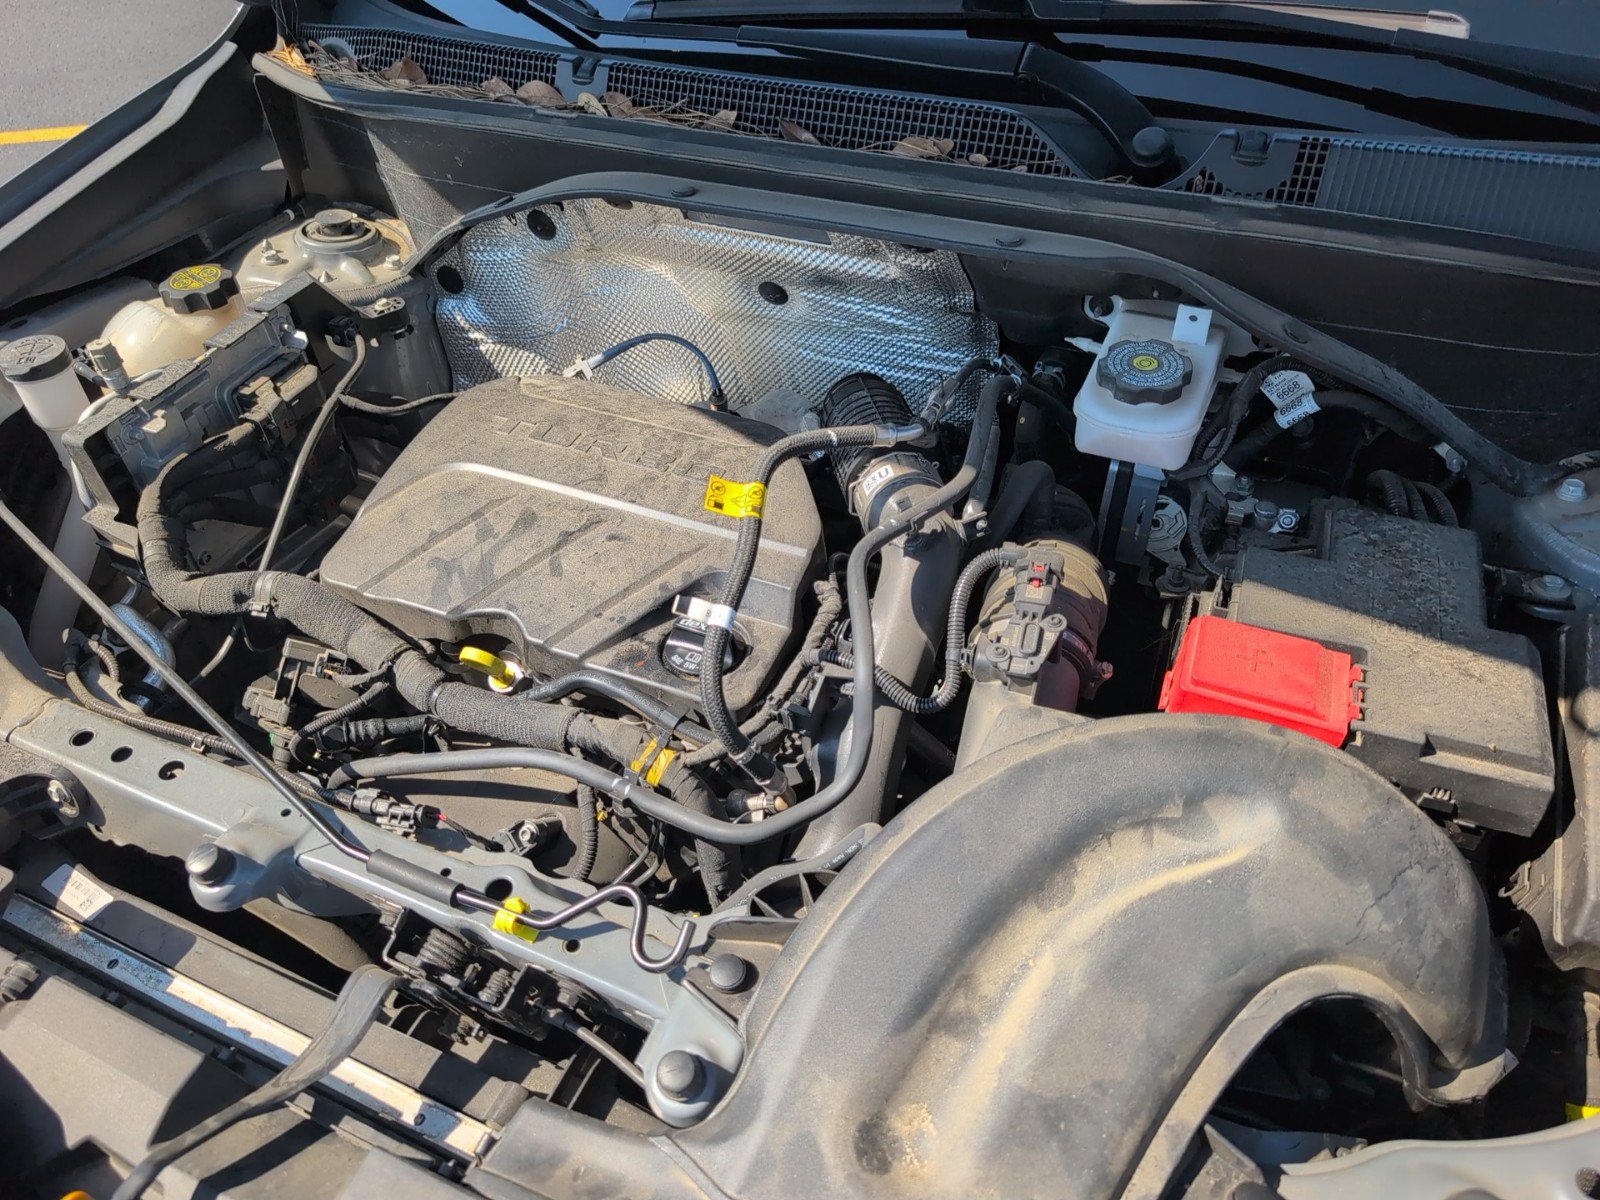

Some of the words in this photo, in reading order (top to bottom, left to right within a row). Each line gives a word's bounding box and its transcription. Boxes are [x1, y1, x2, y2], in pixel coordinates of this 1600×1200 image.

[1277, 381, 1300, 399] 6668
[495, 416, 726, 484] TURBO
[680, 619, 707, 630] dex
[684, 662, 699, 670] 5W-
